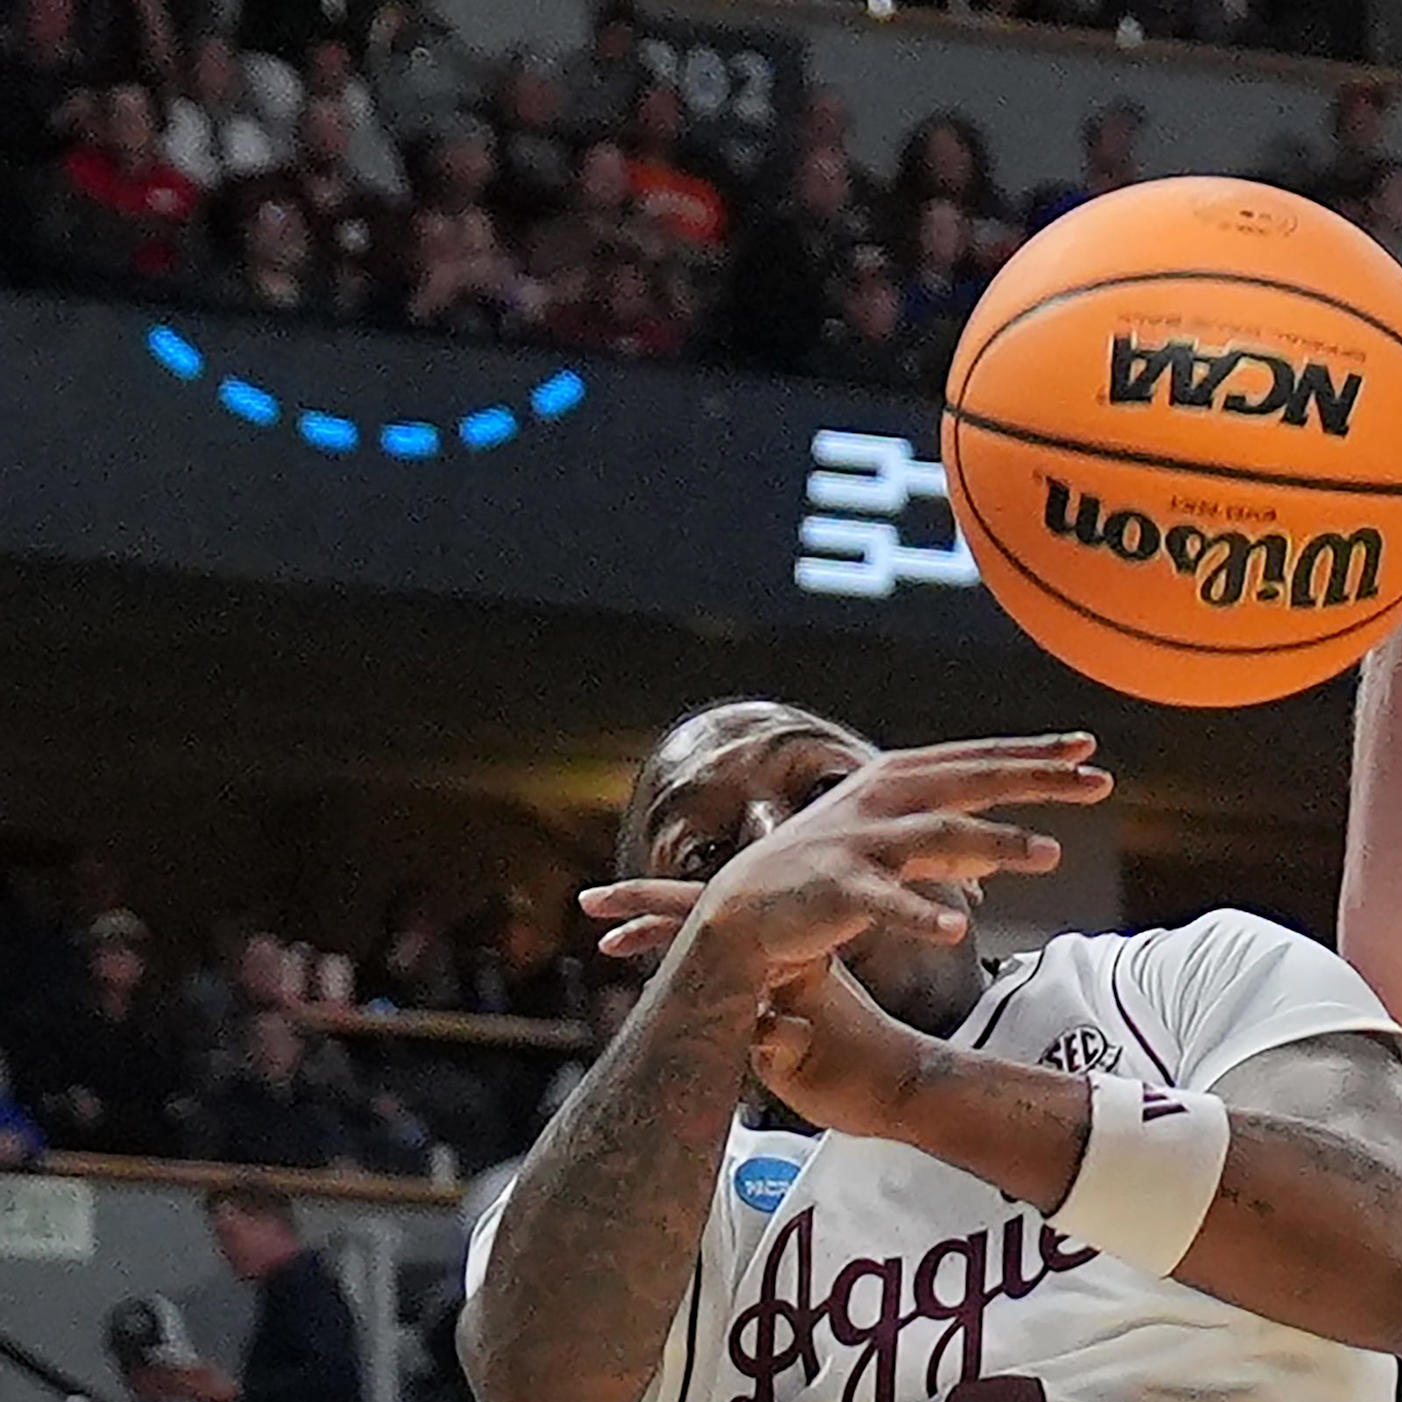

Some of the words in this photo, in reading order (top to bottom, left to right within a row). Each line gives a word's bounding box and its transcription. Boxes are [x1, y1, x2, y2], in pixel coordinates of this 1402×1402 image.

[1108, 334, 1363, 438] NCAA
[1044, 476, 1381, 608] Wilson
[1044, 1030, 1100, 1073] SEC
